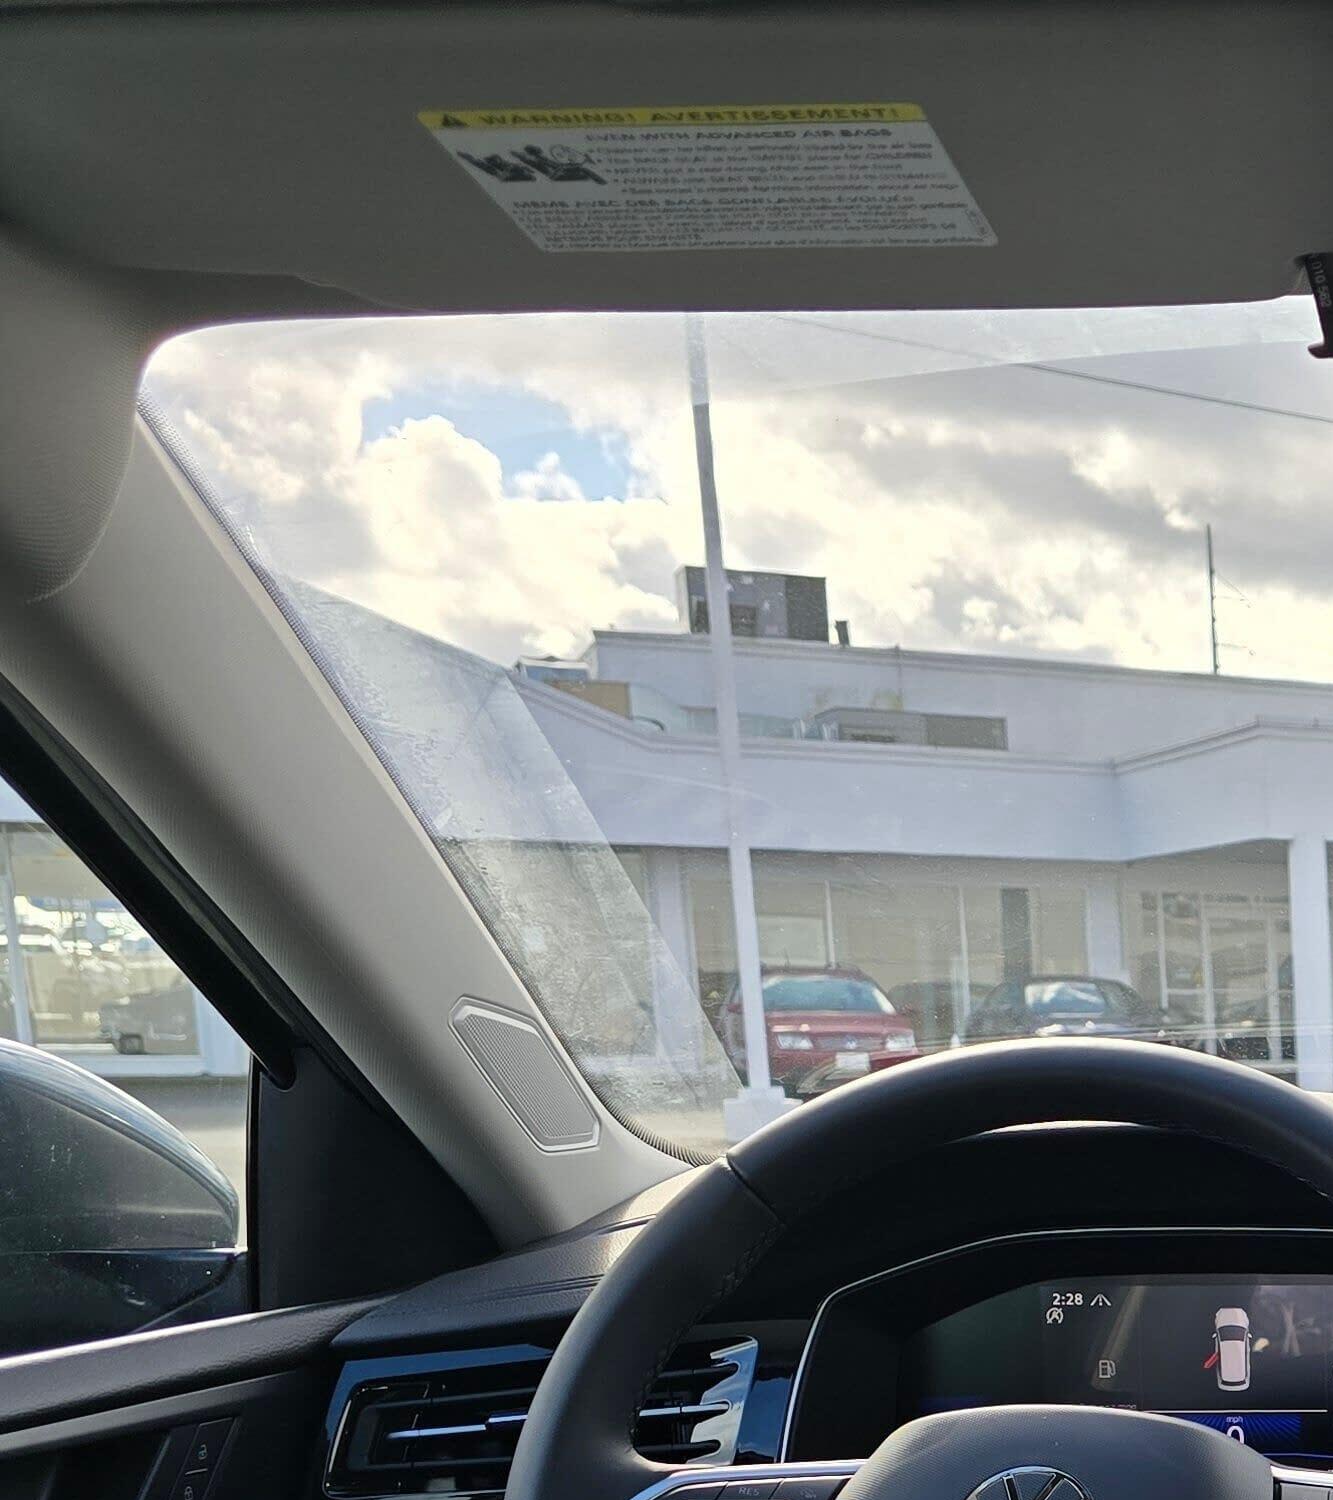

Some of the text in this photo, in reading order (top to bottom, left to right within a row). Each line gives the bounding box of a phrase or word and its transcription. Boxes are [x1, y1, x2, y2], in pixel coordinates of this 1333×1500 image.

[479, 108, 898, 125] WARNING! AVERTISSEMENT!
[1052, 1292, 1084, 1306] 2:28
[1226, 1416, 1244, 1424] mph
[738, 1487, 760, 1496] RES
